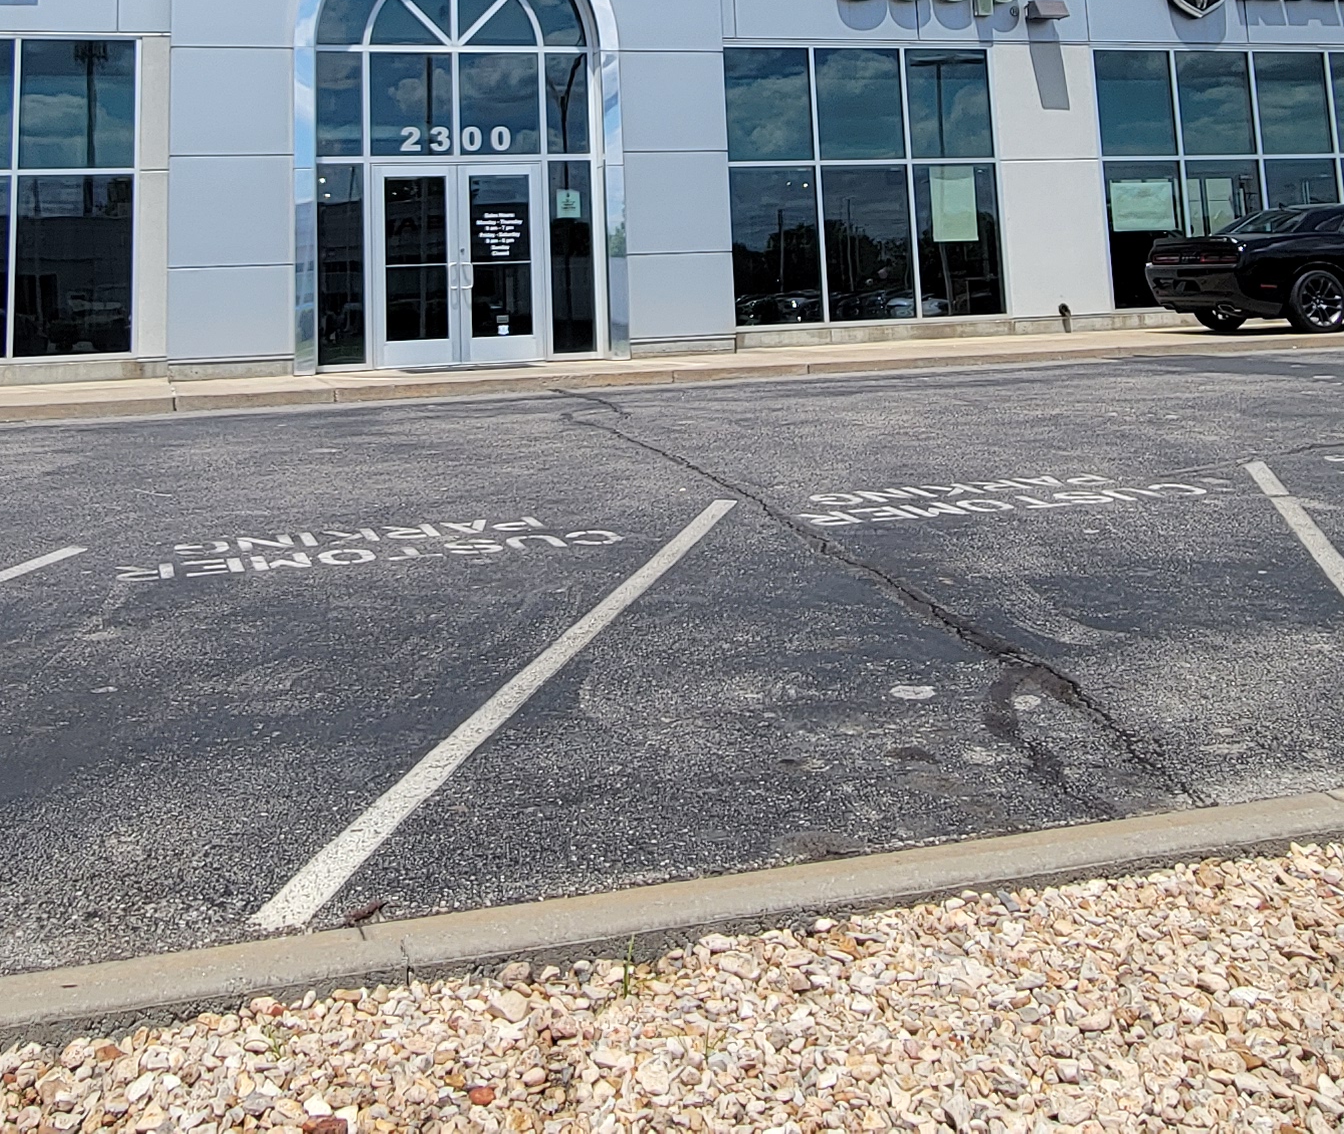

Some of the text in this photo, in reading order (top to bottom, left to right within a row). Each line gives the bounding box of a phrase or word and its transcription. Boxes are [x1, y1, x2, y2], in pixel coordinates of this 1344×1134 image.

[399, 126, 511, 152] 2300
[797, 483, 1207, 526] CUSTOMER
[808, 473, 1116, 506] PARKING
[114, 529, 623, 582] CUSTOMER
[174, 516, 546, 556] PARKING
